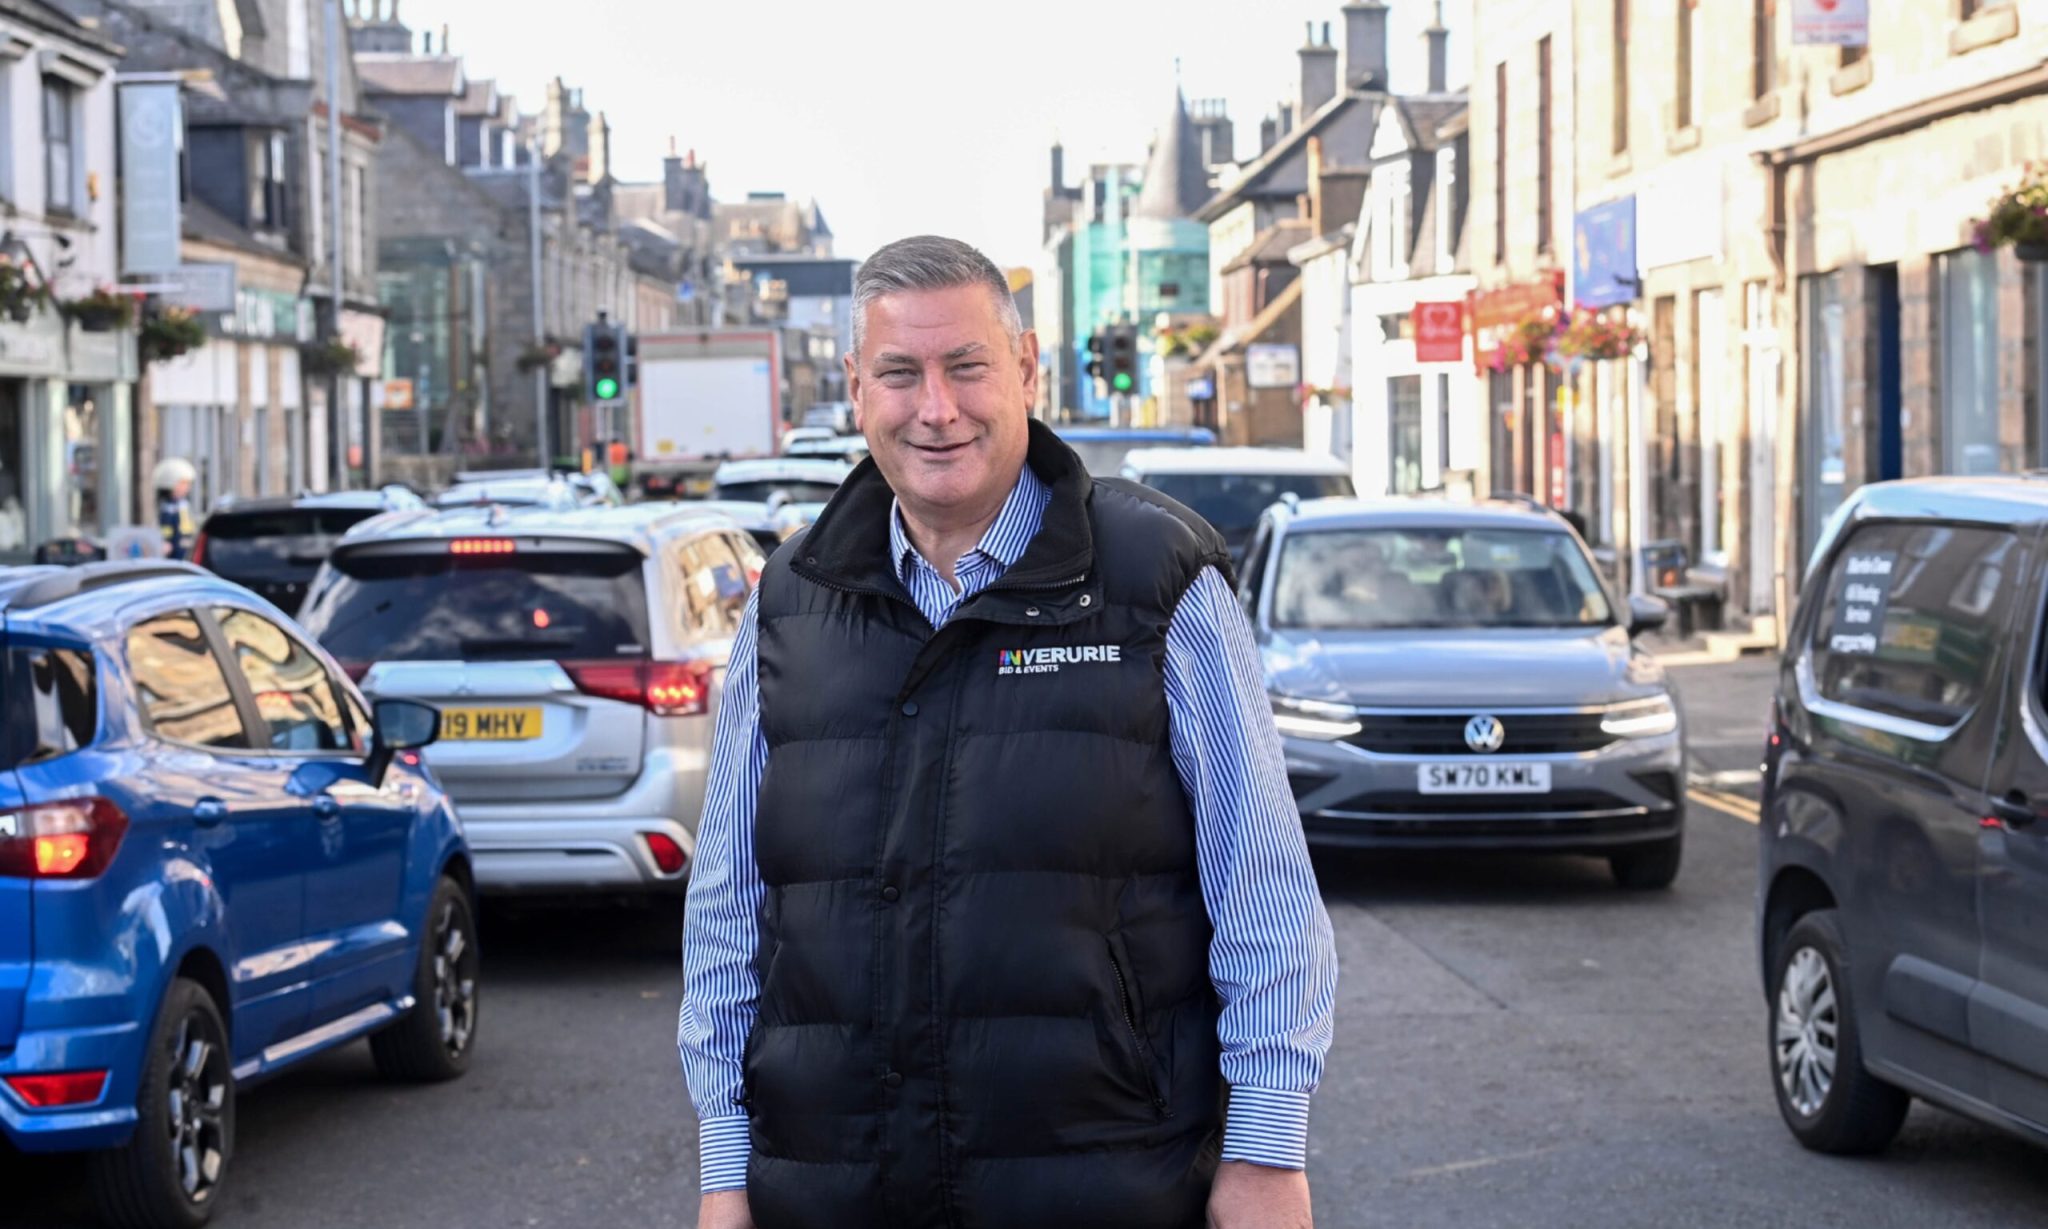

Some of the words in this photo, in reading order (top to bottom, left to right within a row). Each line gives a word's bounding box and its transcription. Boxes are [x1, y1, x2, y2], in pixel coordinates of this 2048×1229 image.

[998, 645, 1121, 666] INVERURIE
[998, 666, 1014, 675] BID
[1015, 665, 1022, 674] &
[1023, 664, 1059, 674] EVENTS
[476, 711, 526, 734] MHV
[1429, 765, 1490, 787] SW70
[1495, 765, 1540, 786] KWL
